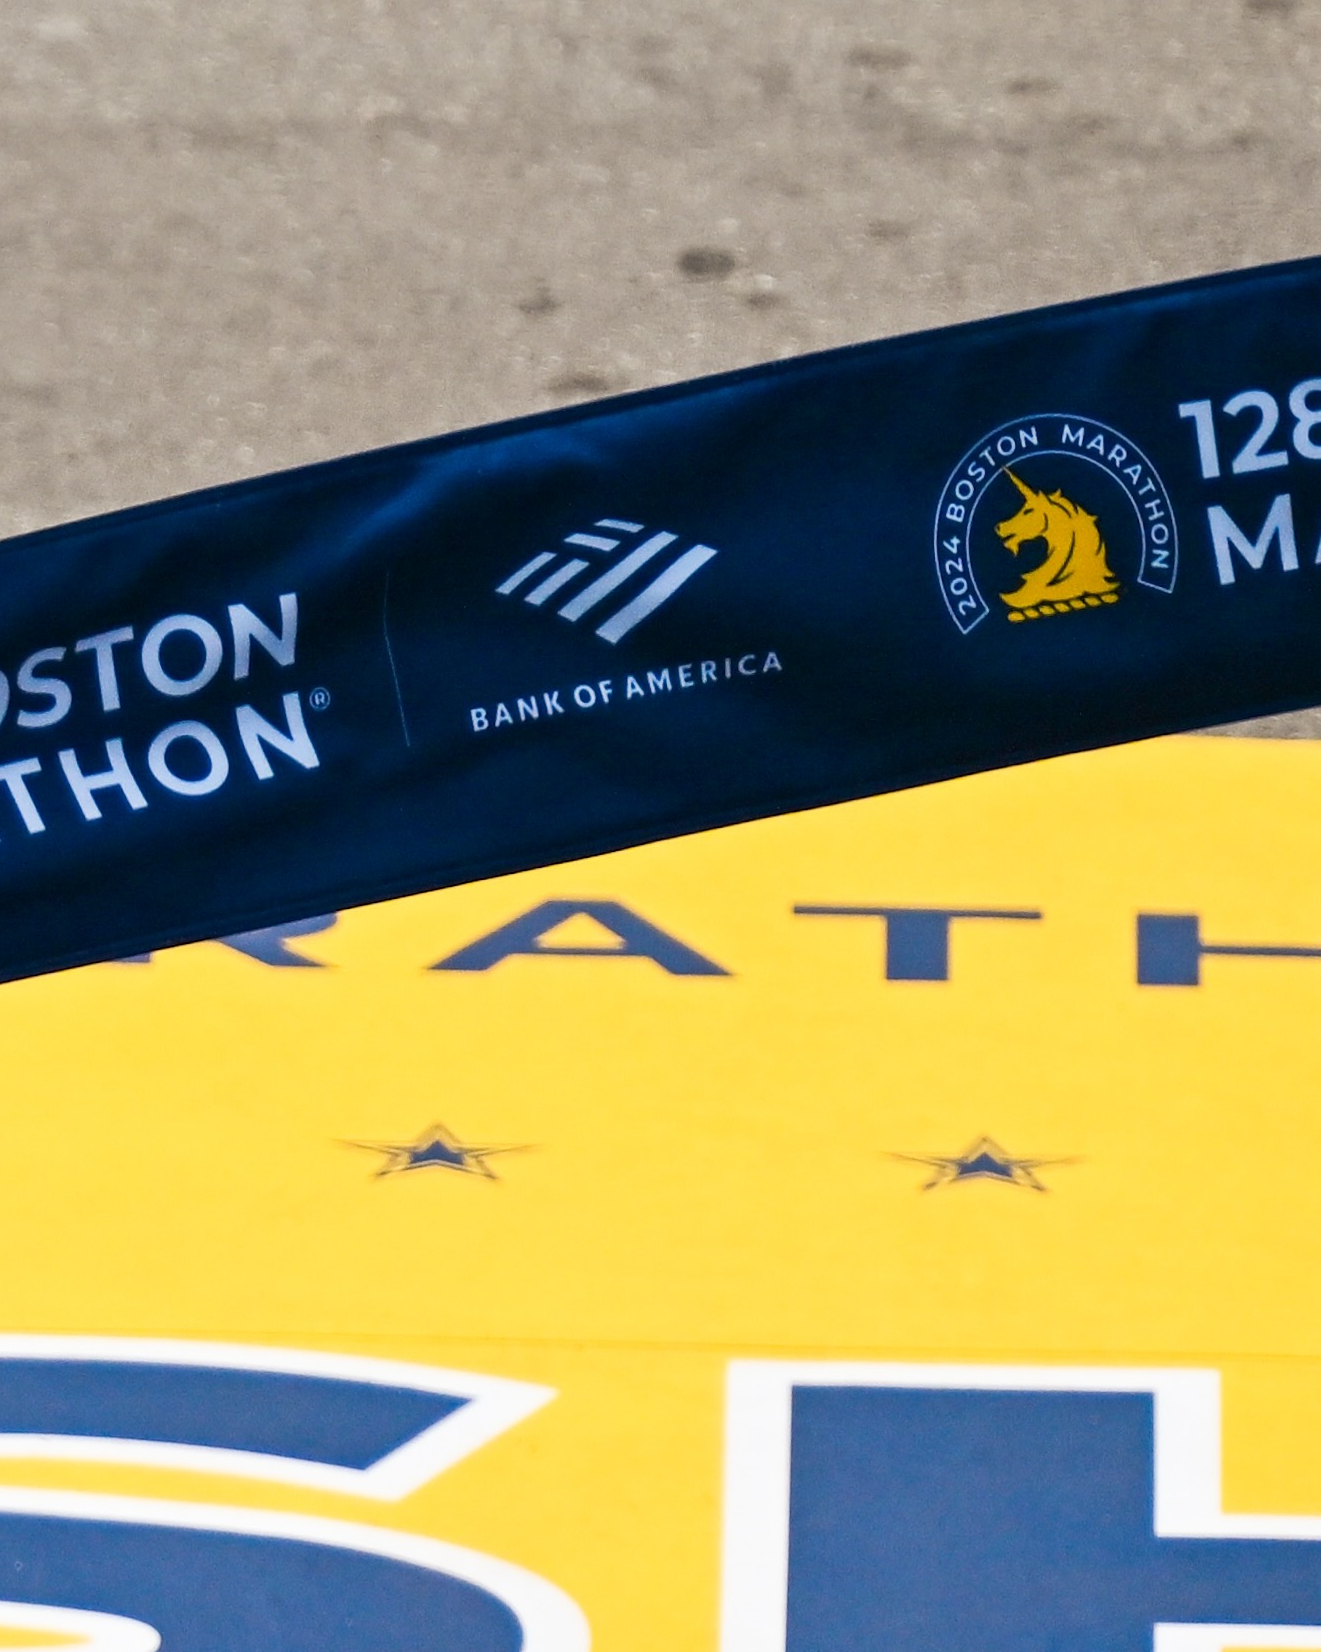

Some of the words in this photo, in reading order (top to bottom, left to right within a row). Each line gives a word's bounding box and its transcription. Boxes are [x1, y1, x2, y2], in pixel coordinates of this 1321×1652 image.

[945, 426, 1040, 524] BOSTON
[1060, 423, 1171, 569] MARATHON
[944, 535, 977, 616] 2024
[1207, 493, 1321, 586] M
[470, 690, 565, 733] BANK
[573, 679, 614, 709] OF
[626, 651, 783, 701] AMERICA
